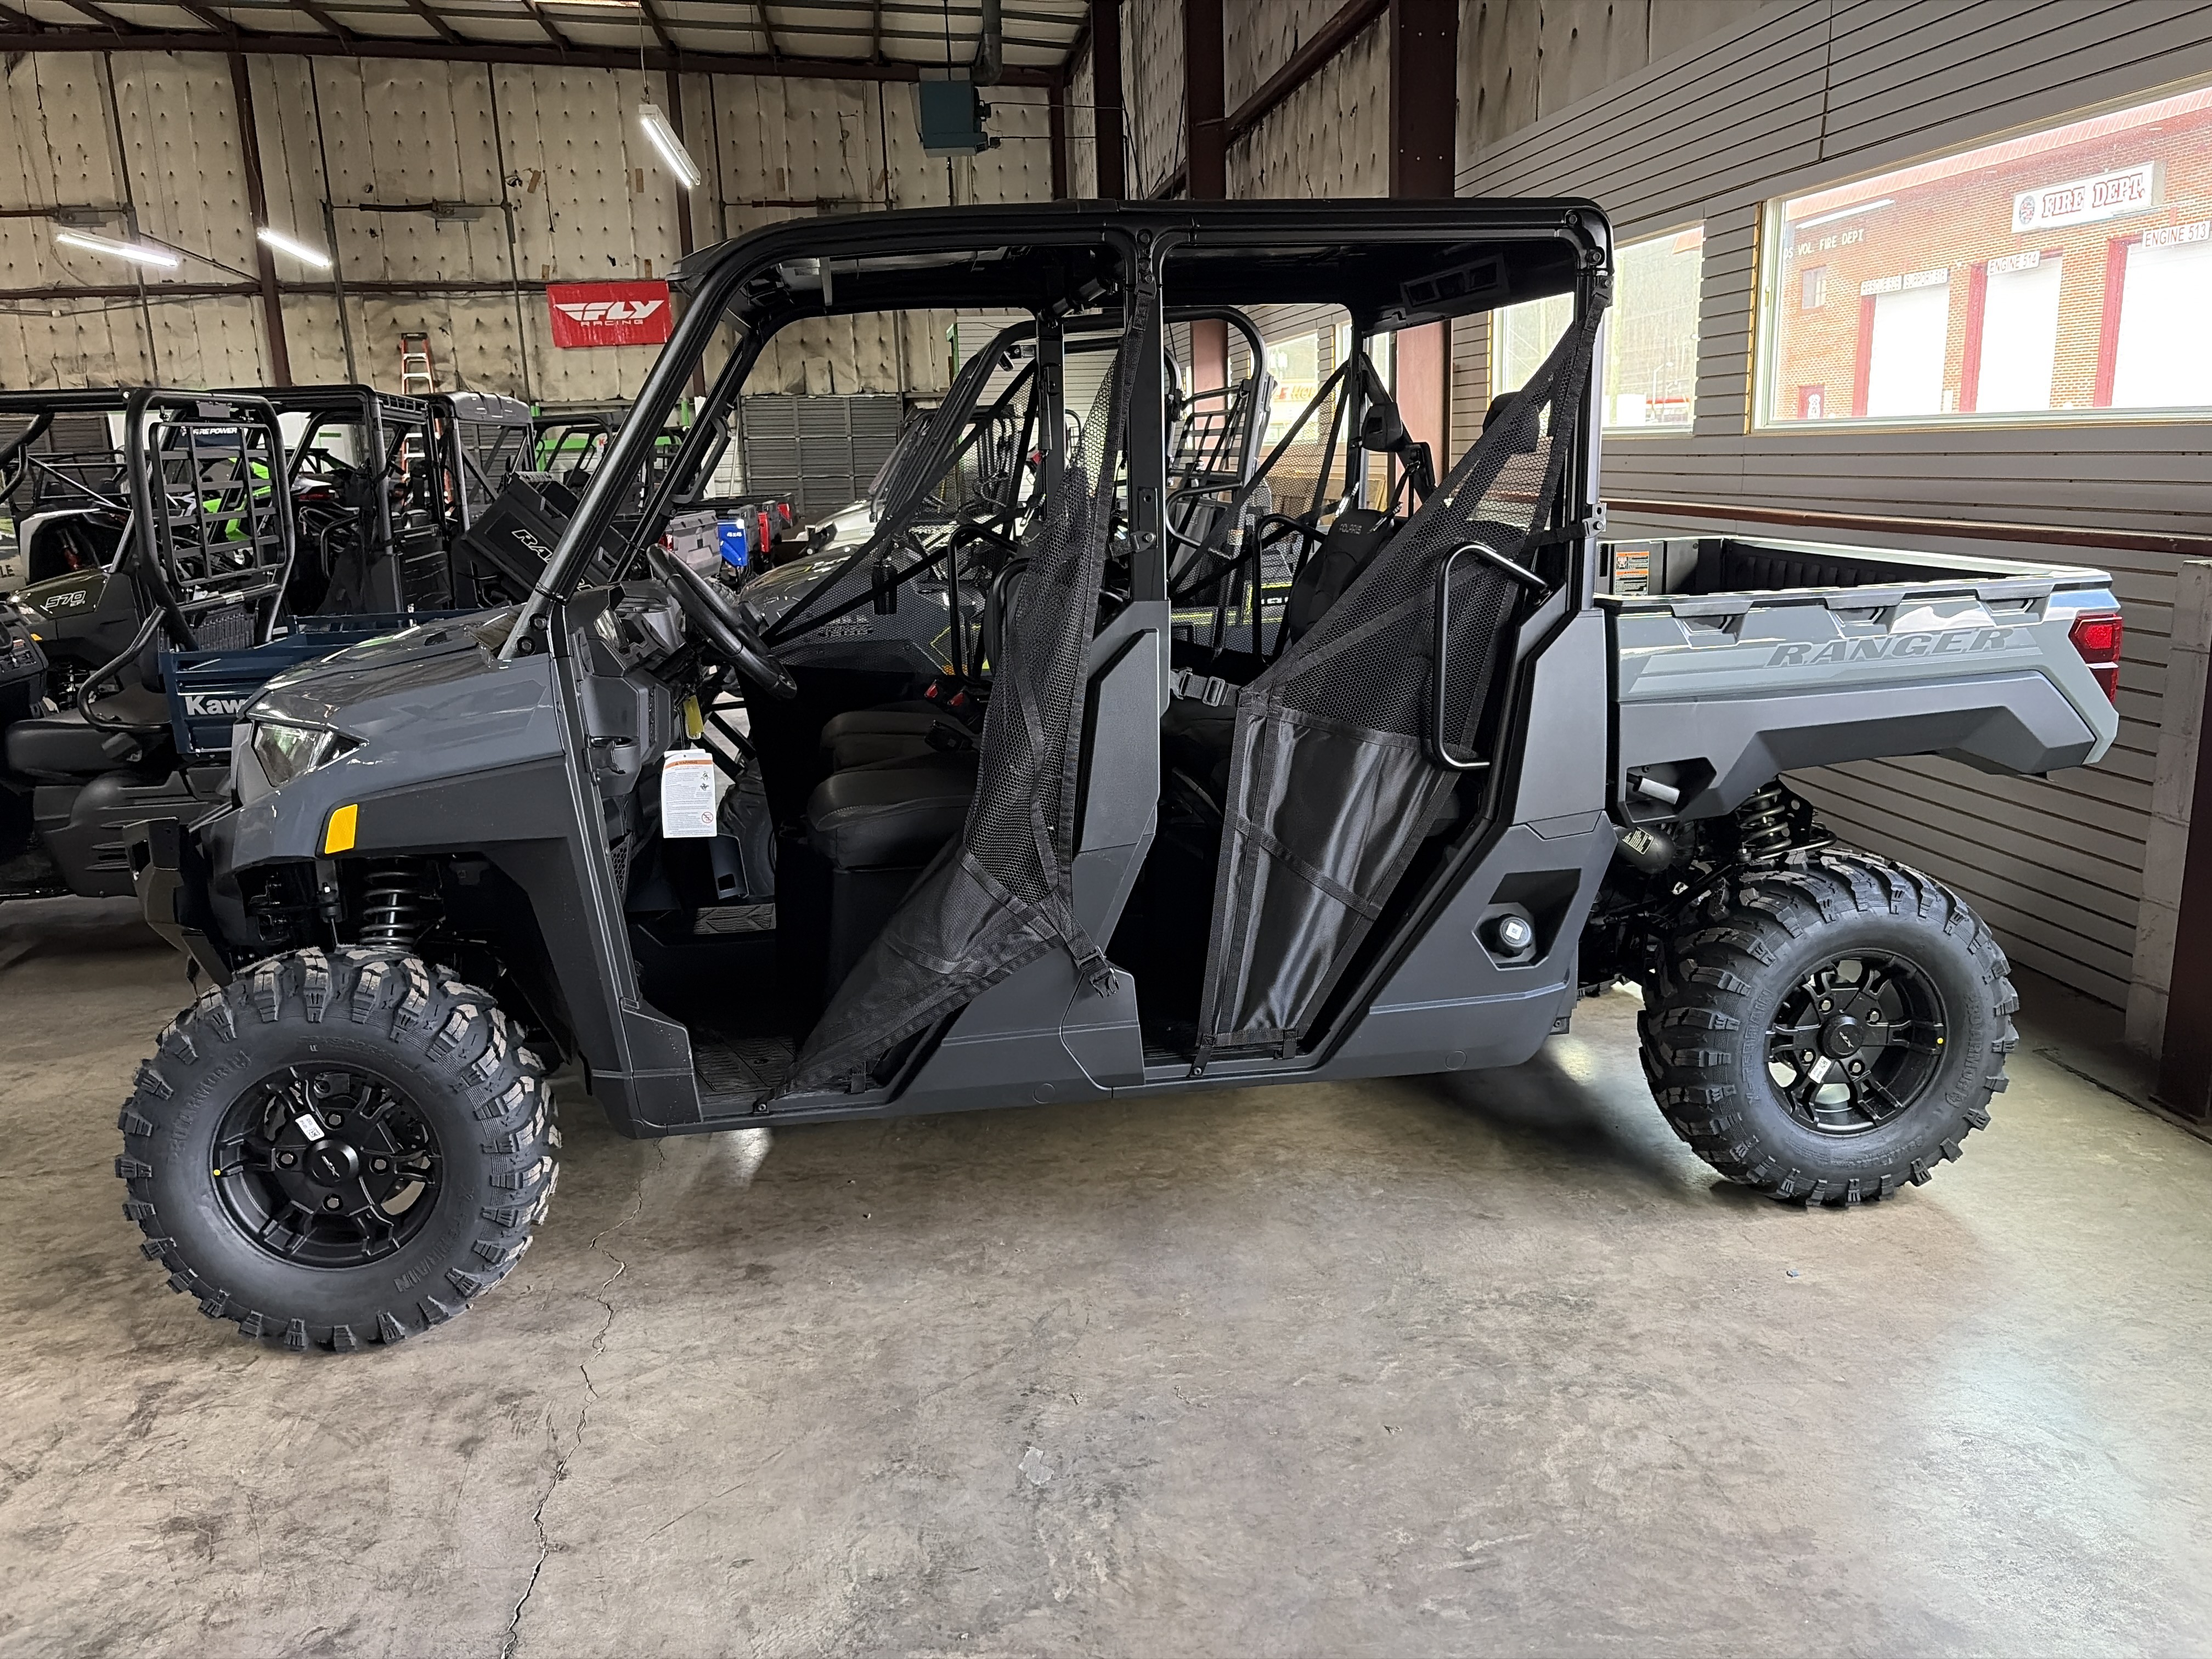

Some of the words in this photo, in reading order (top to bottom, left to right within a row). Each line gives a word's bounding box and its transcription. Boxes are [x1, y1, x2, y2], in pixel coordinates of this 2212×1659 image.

[2041, 186, 2085, 218] FIRE
[2092, 173, 2145, 208] DEPT.
[1819, 234, 1837, 251] FIRE
[2145, 227, 2185, 247] ENGINE
[2188, 223, 2207, 241] 513
[1989, 256, 2021, 273] ENGINE
[555, 300, 664, 321] FLY
[45, 590, 86, 608] 570
[1766, 628, 2015, 668] RANGER
